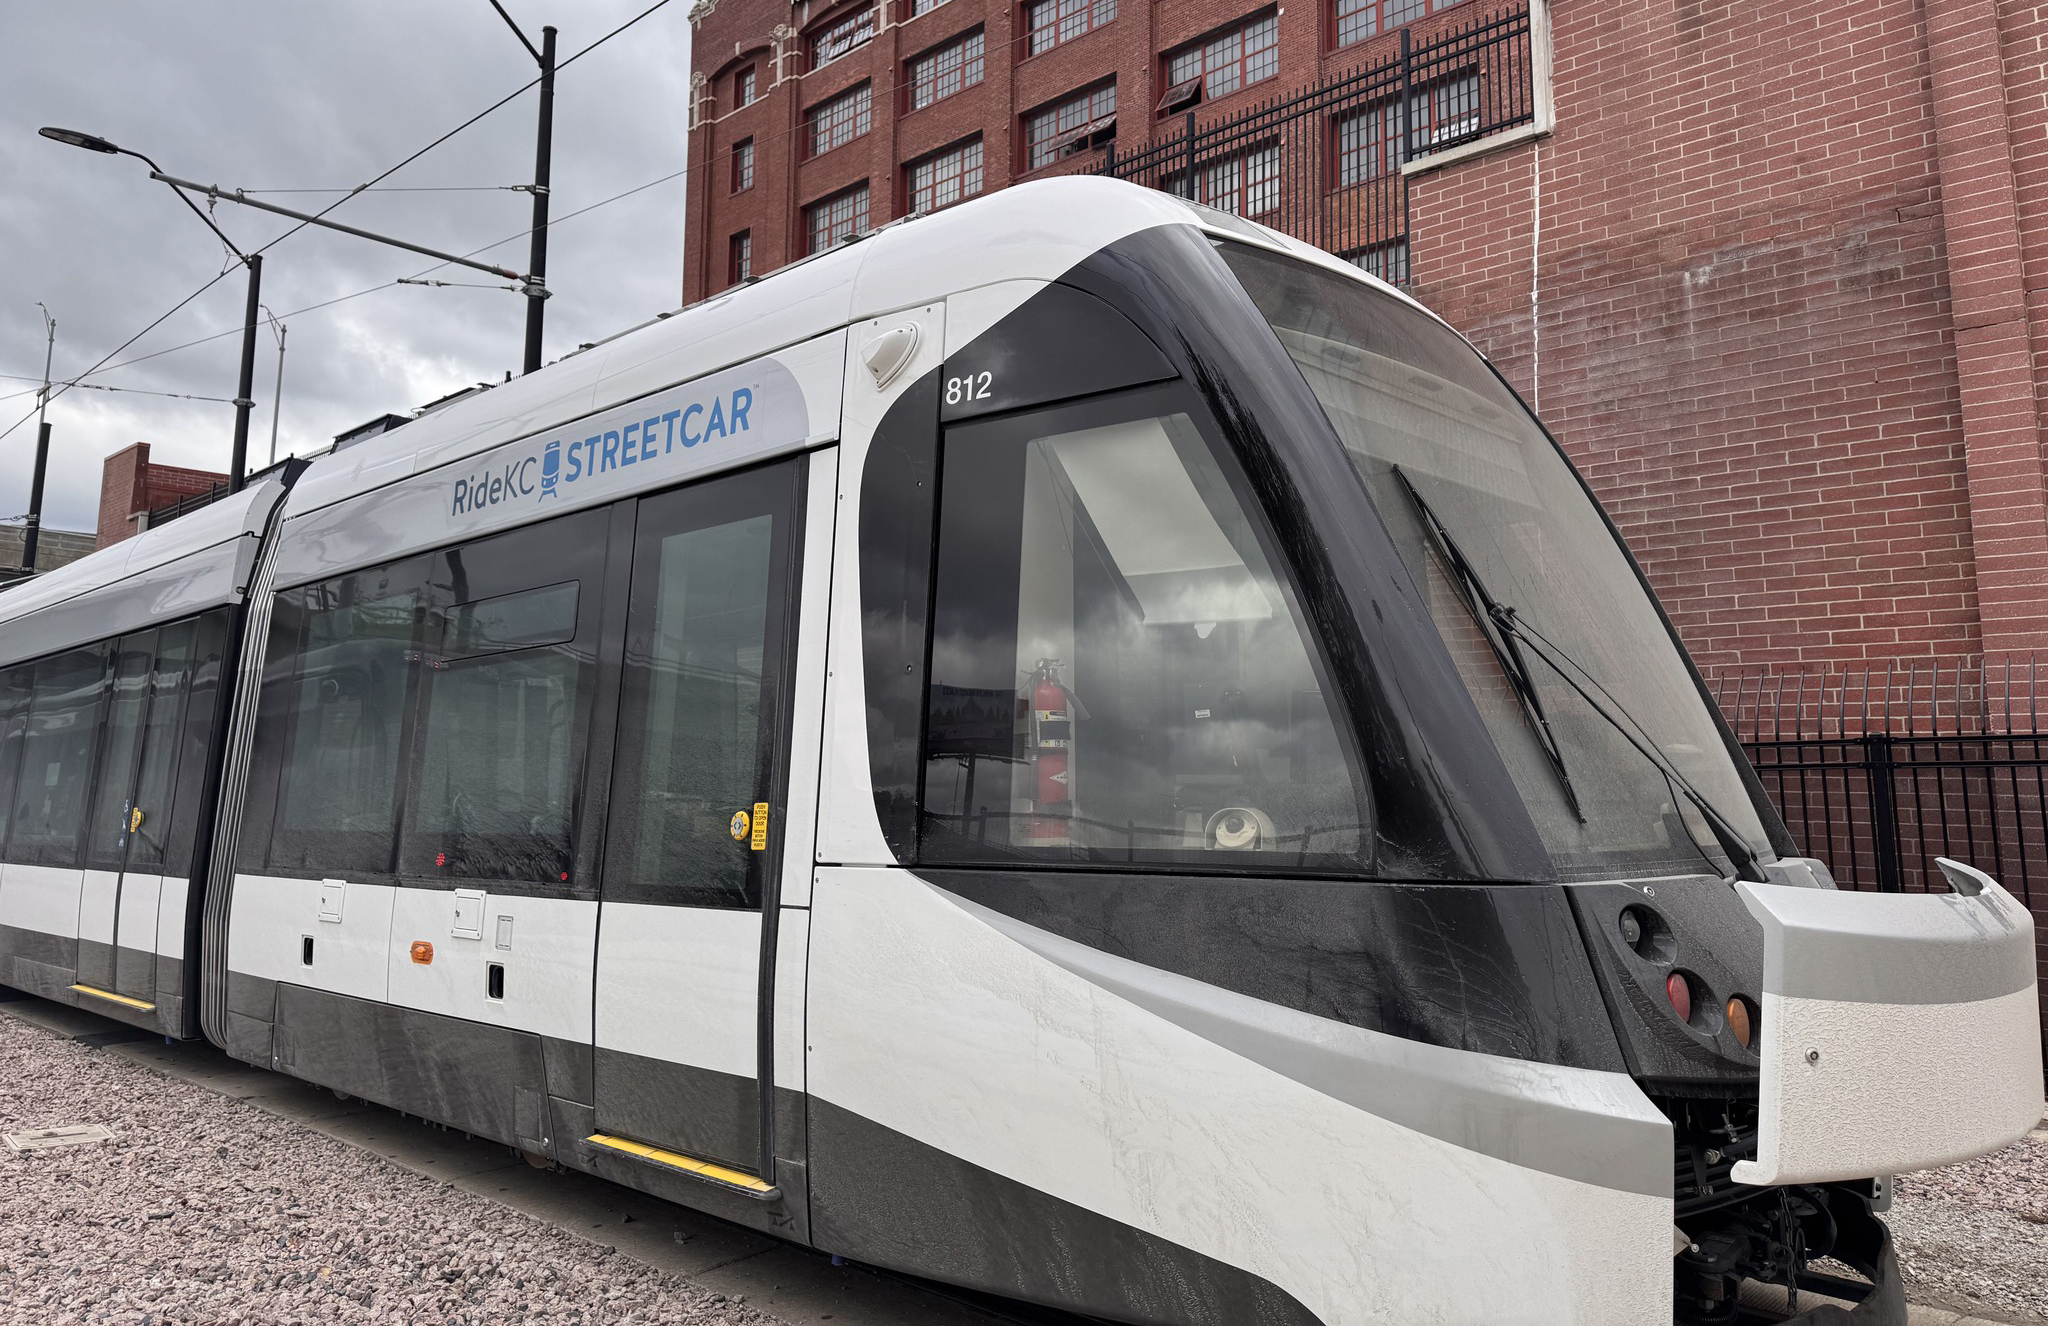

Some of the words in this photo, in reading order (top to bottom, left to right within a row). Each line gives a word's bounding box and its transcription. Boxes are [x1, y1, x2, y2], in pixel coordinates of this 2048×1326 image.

[946, 371, 992, 405] 812
[452, 456, 537, 517] RideKC
[564, 387, 753, 482] STREETCAR
